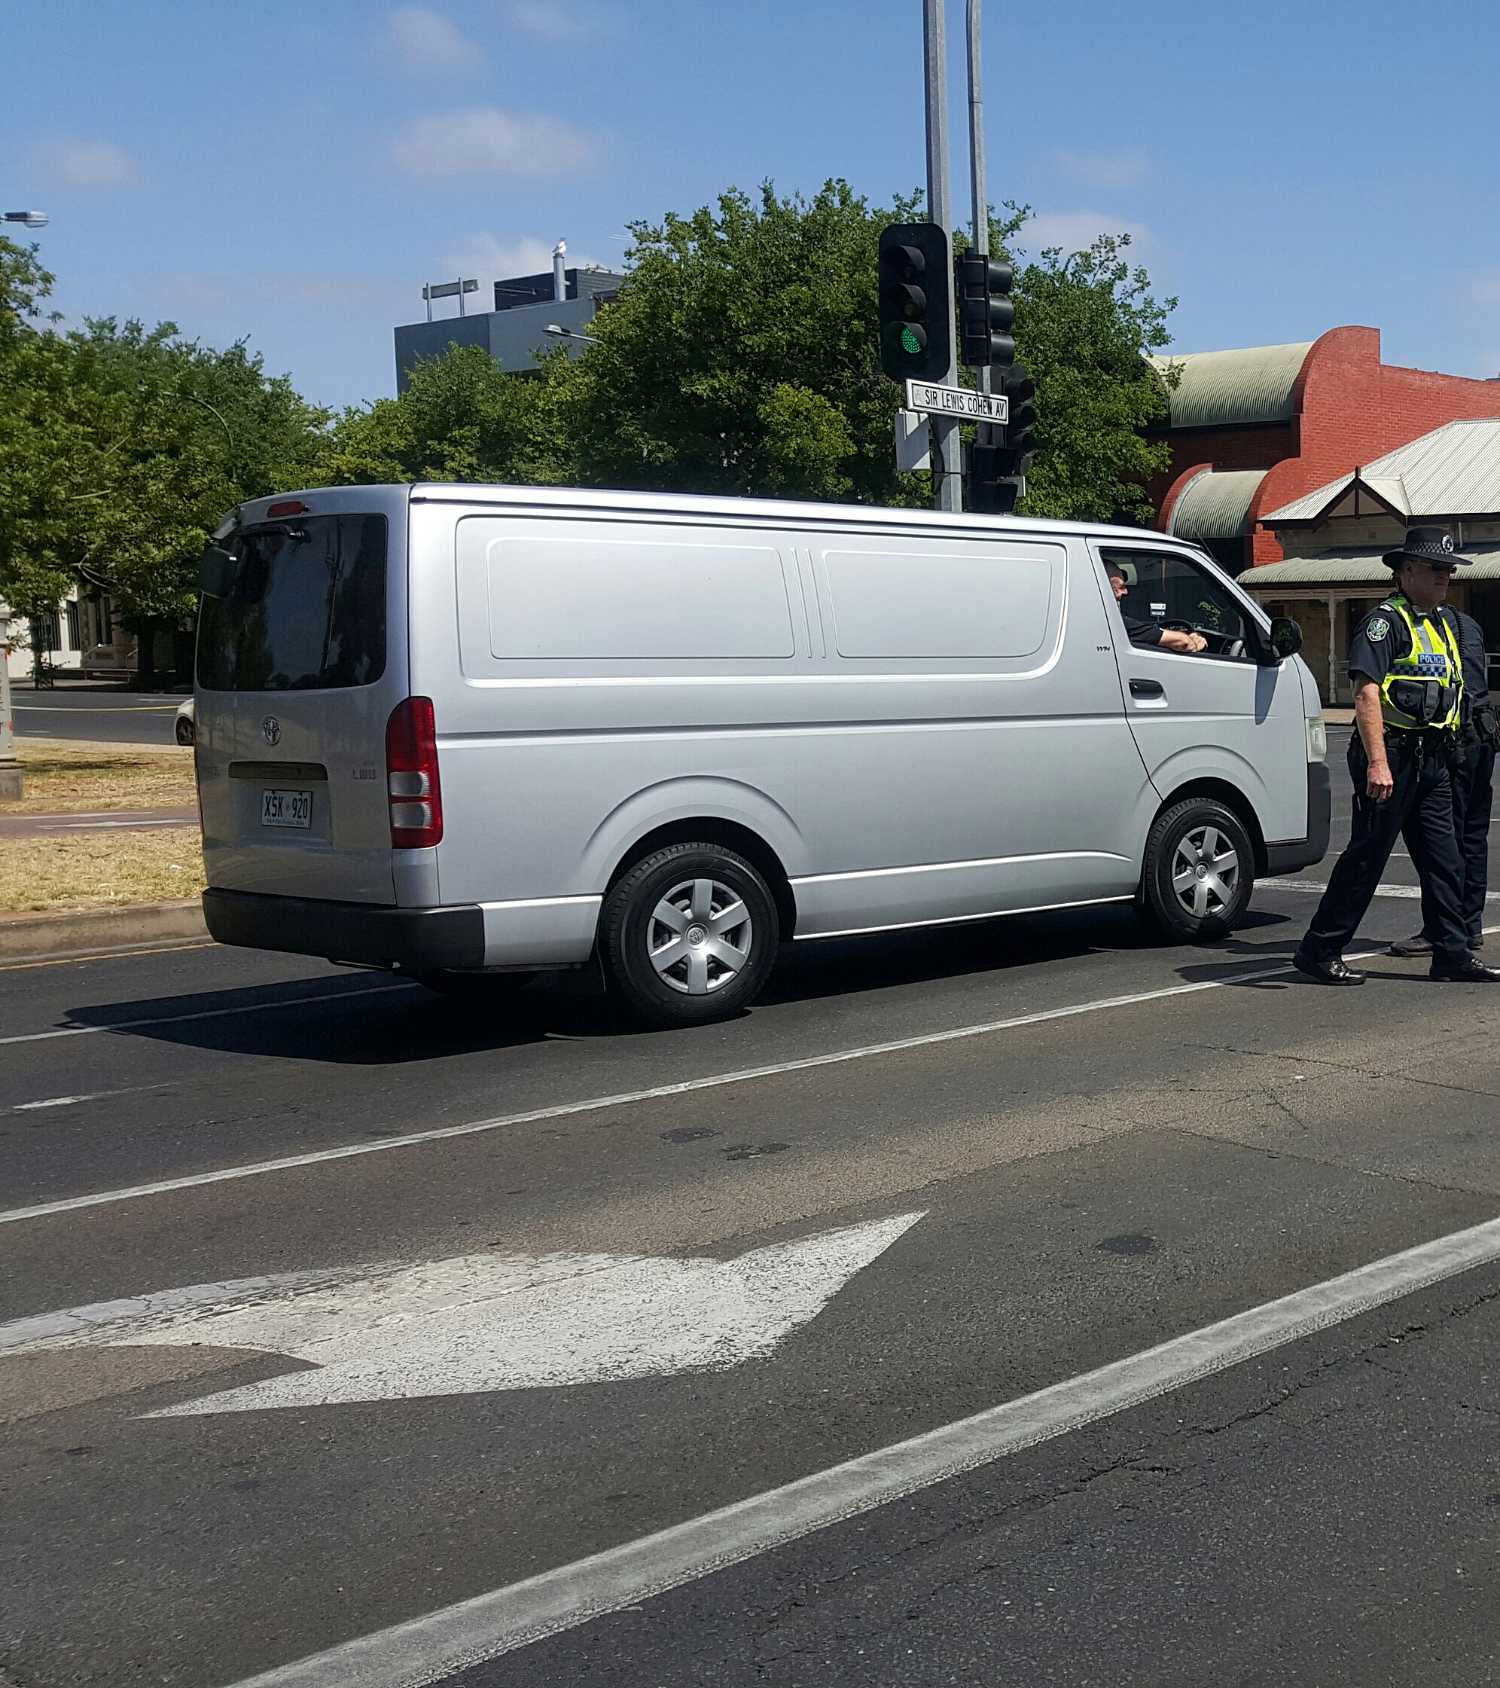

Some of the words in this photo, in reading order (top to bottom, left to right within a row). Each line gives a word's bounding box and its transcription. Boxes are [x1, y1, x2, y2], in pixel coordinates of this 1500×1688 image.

[925, 389, 938, 406] SIR
[941, 393, 965, 411] LEWIS
[967, 397, 992, 417] COHEN
[995, 402, 1005, 418] AV
[1420, 654, 1445, 665] POLICE
[264, 795, 284, 817] XSK
[292, 797, 308, 819] 920
